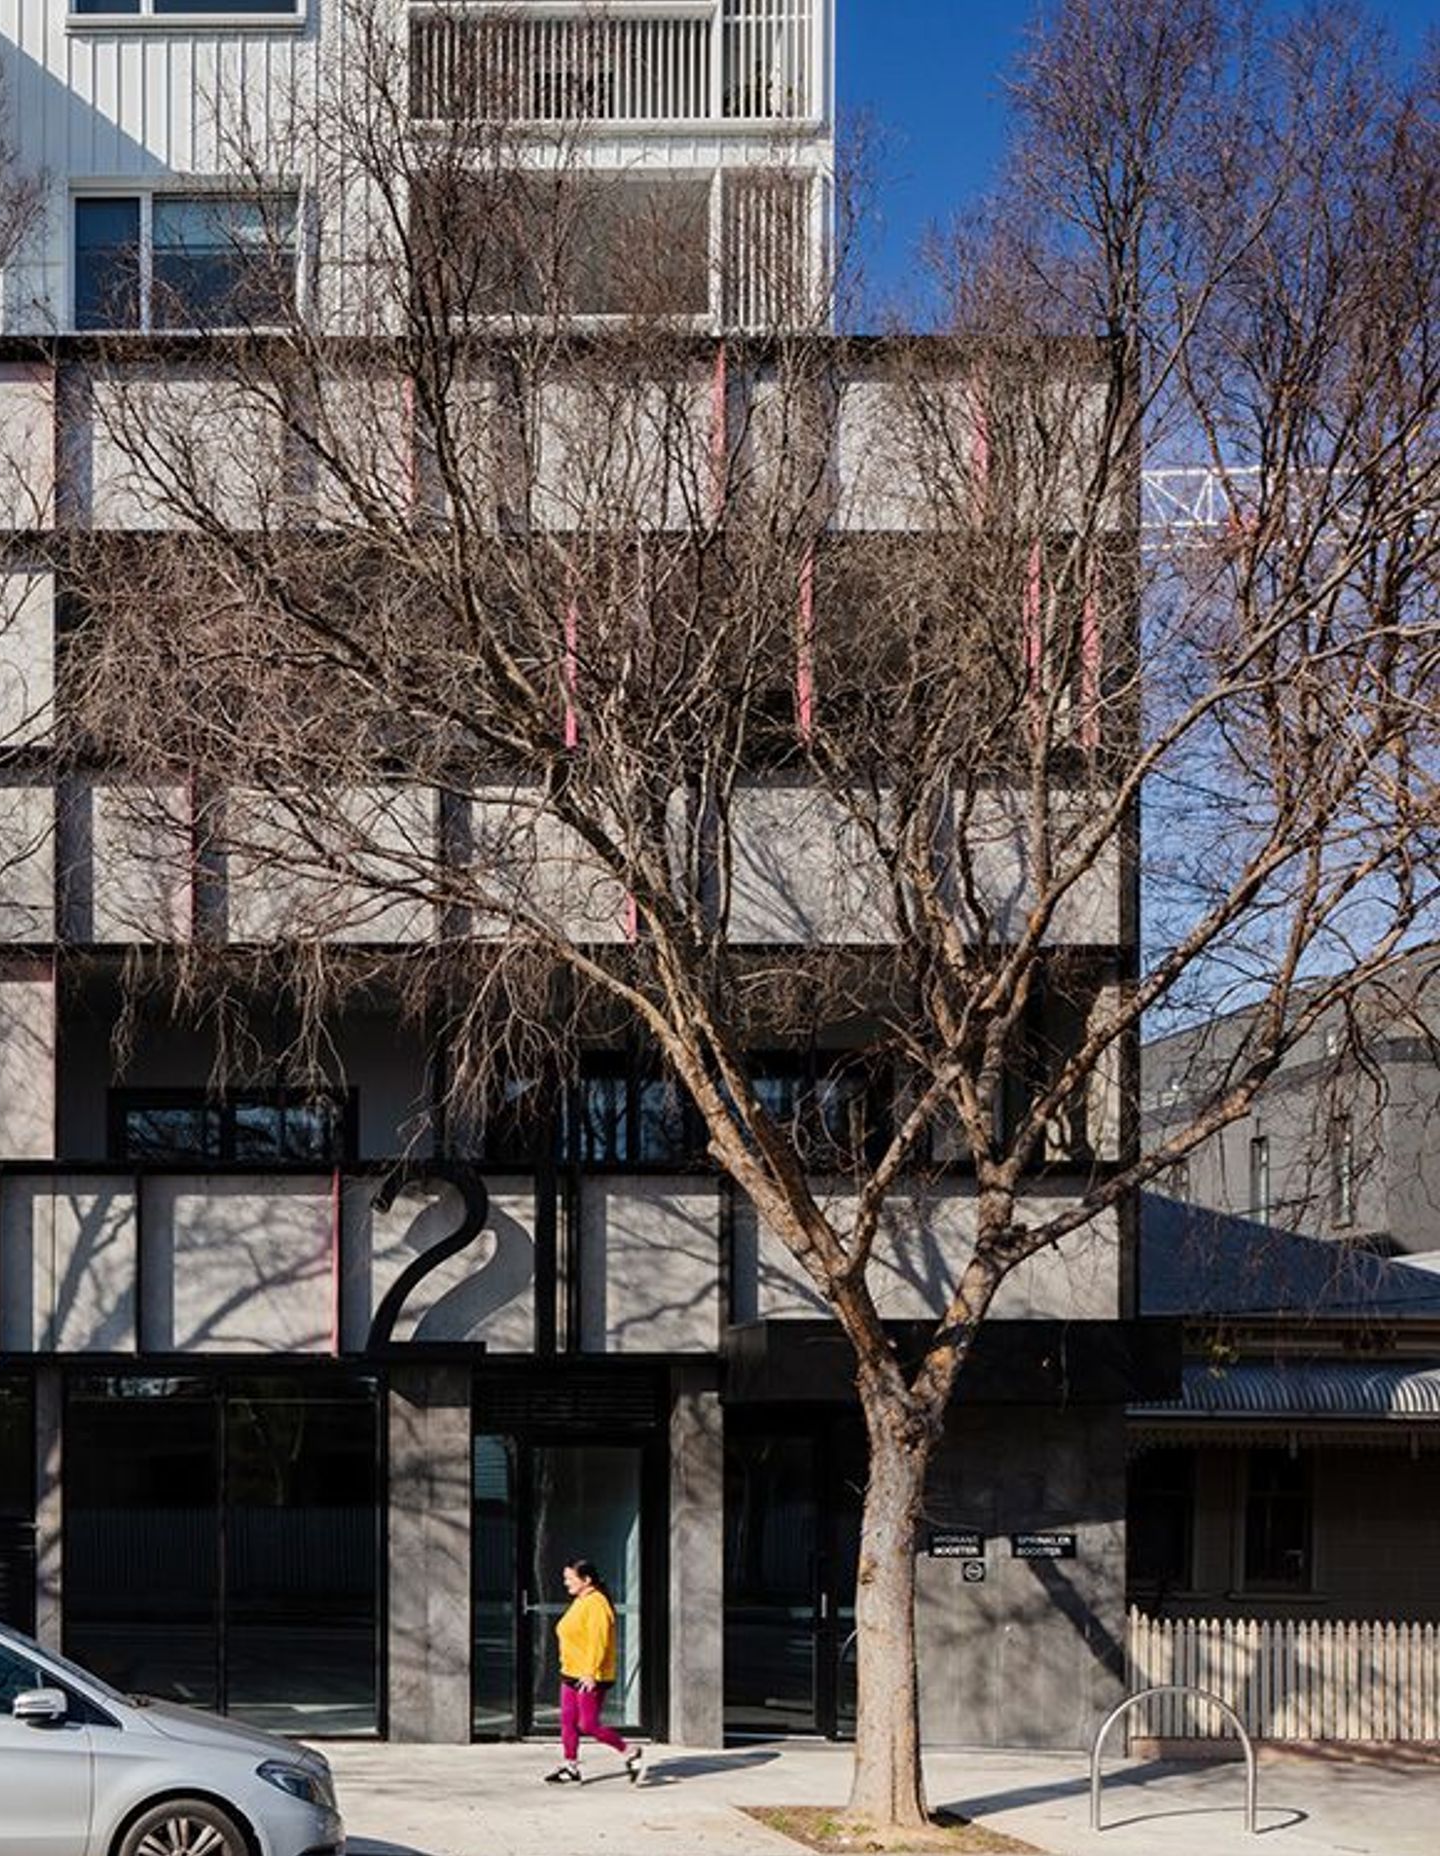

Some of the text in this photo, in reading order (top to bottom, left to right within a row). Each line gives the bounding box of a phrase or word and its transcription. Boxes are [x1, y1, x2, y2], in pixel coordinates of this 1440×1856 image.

[366, 1162, 487, 1360] 2
[1018, 1537, 1071, 1545] SPRINKLER
[934, 1546, 978, 1555] BOOSTER
[1017, 1547, 1061, 1556] BOOSTER
